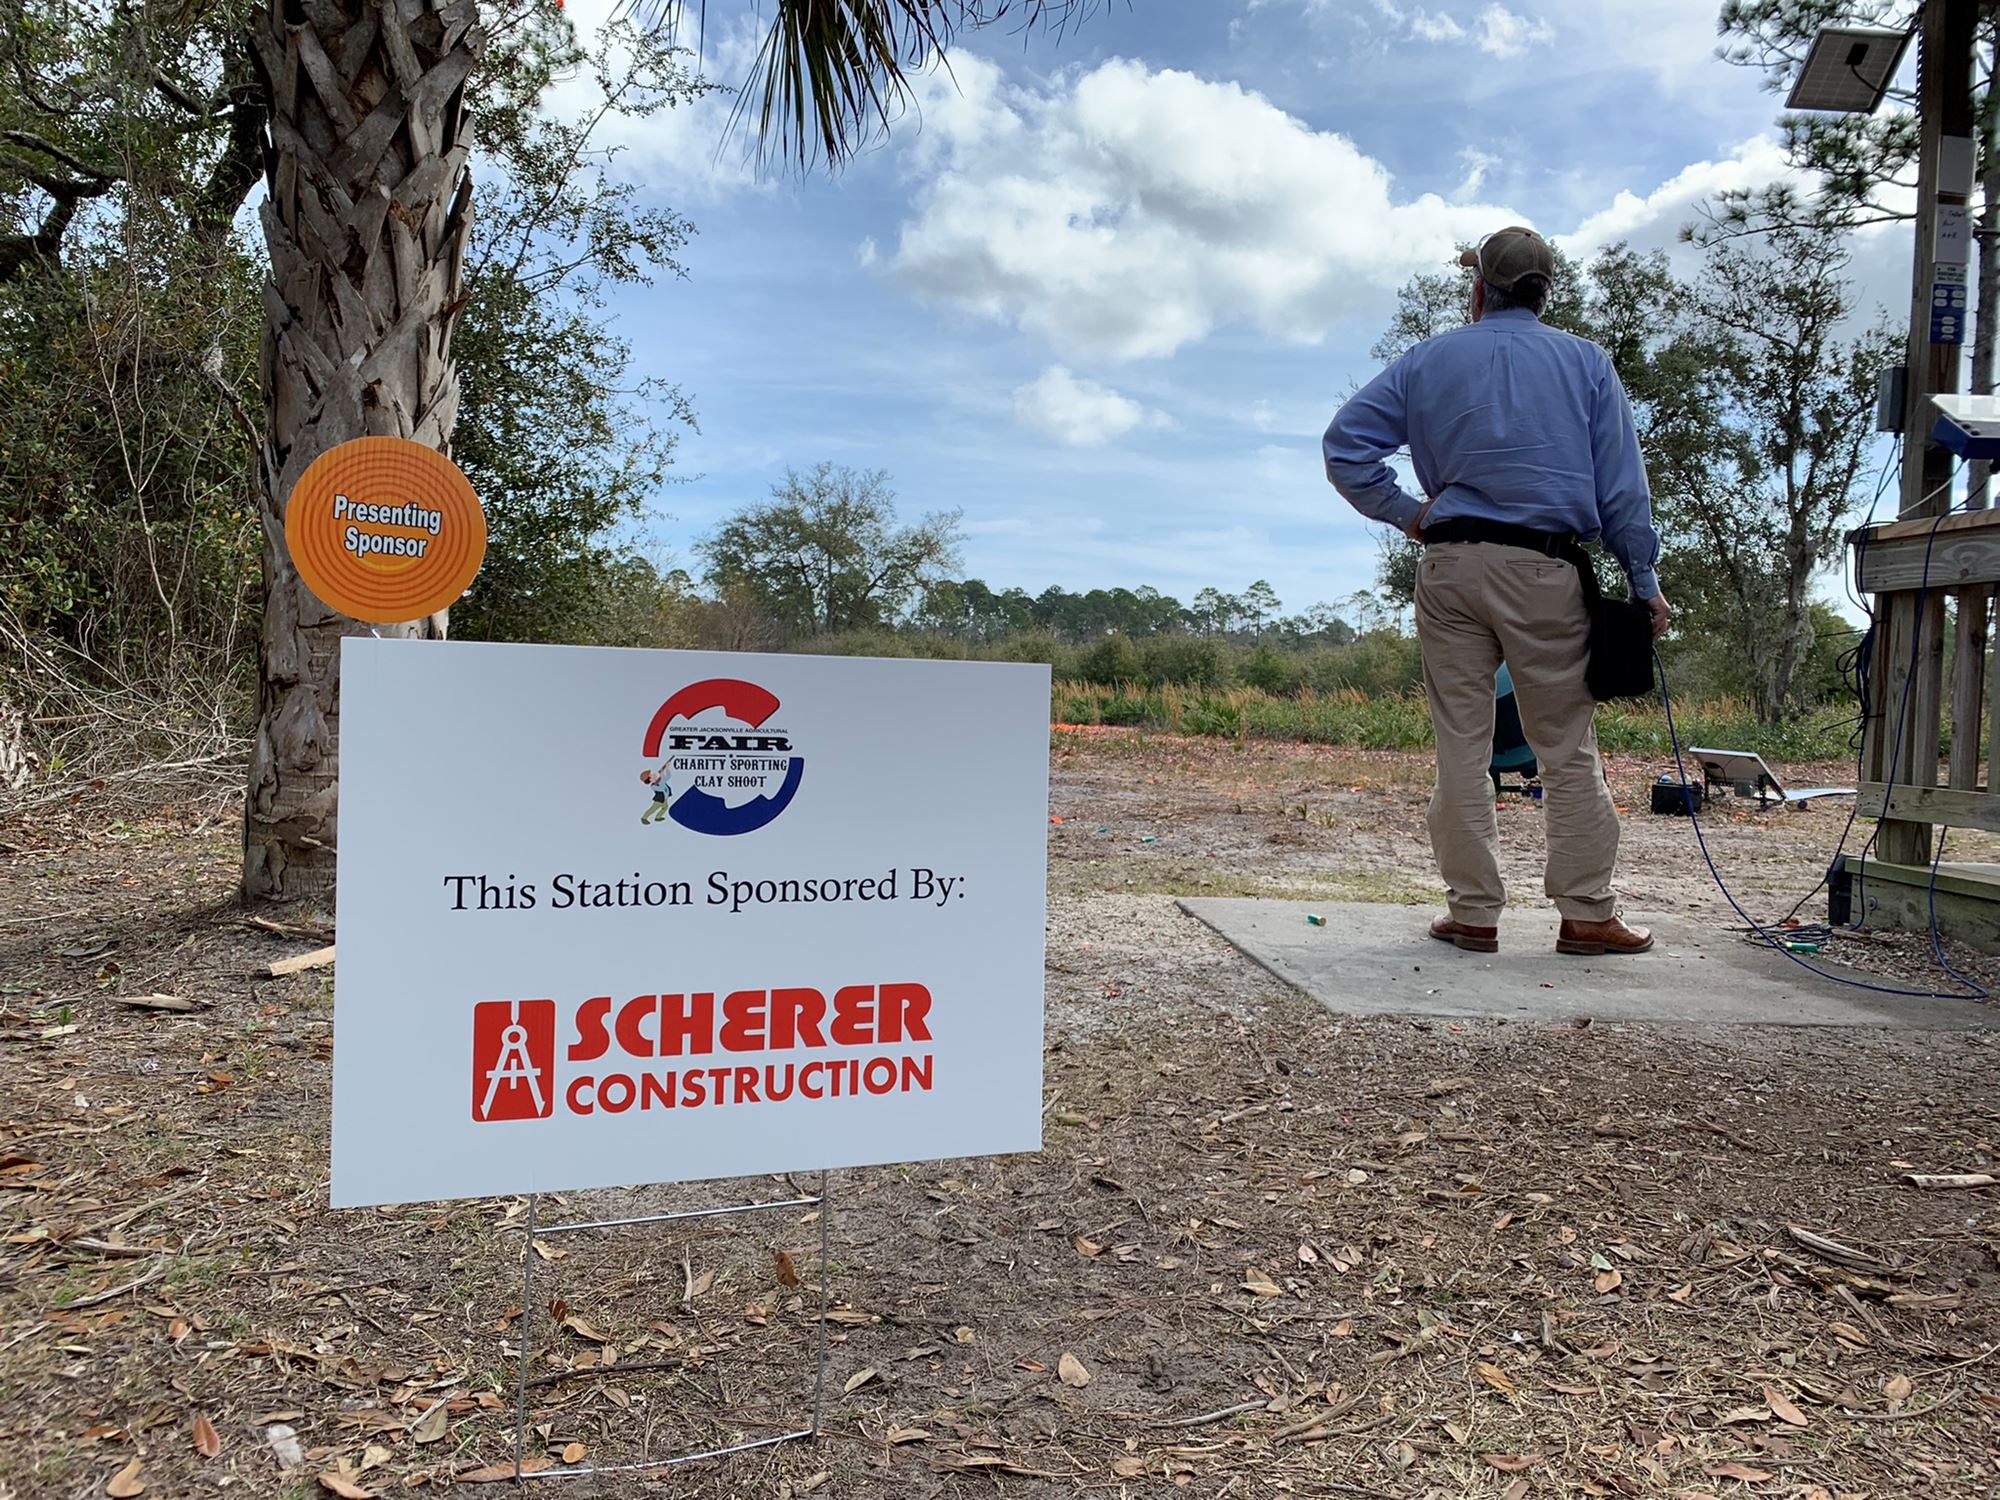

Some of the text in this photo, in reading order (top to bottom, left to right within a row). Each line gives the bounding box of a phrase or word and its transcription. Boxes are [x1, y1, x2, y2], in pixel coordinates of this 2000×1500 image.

[333, 494, 442, 535] Presenting
[344, 525, 428, 558] Sponsor
[669, 735, 793, 751] FAIR
[673, 758, 787, 771] CHARITY SPORTING
[694, 775, 767, 788] CLAY SHOOT
[443, 867, 967, 914] This Station Sponsored By:
[567, 982, 934, 1062] SCHERER
[565, 1054, 934, 1116] CONSTRUCTION
